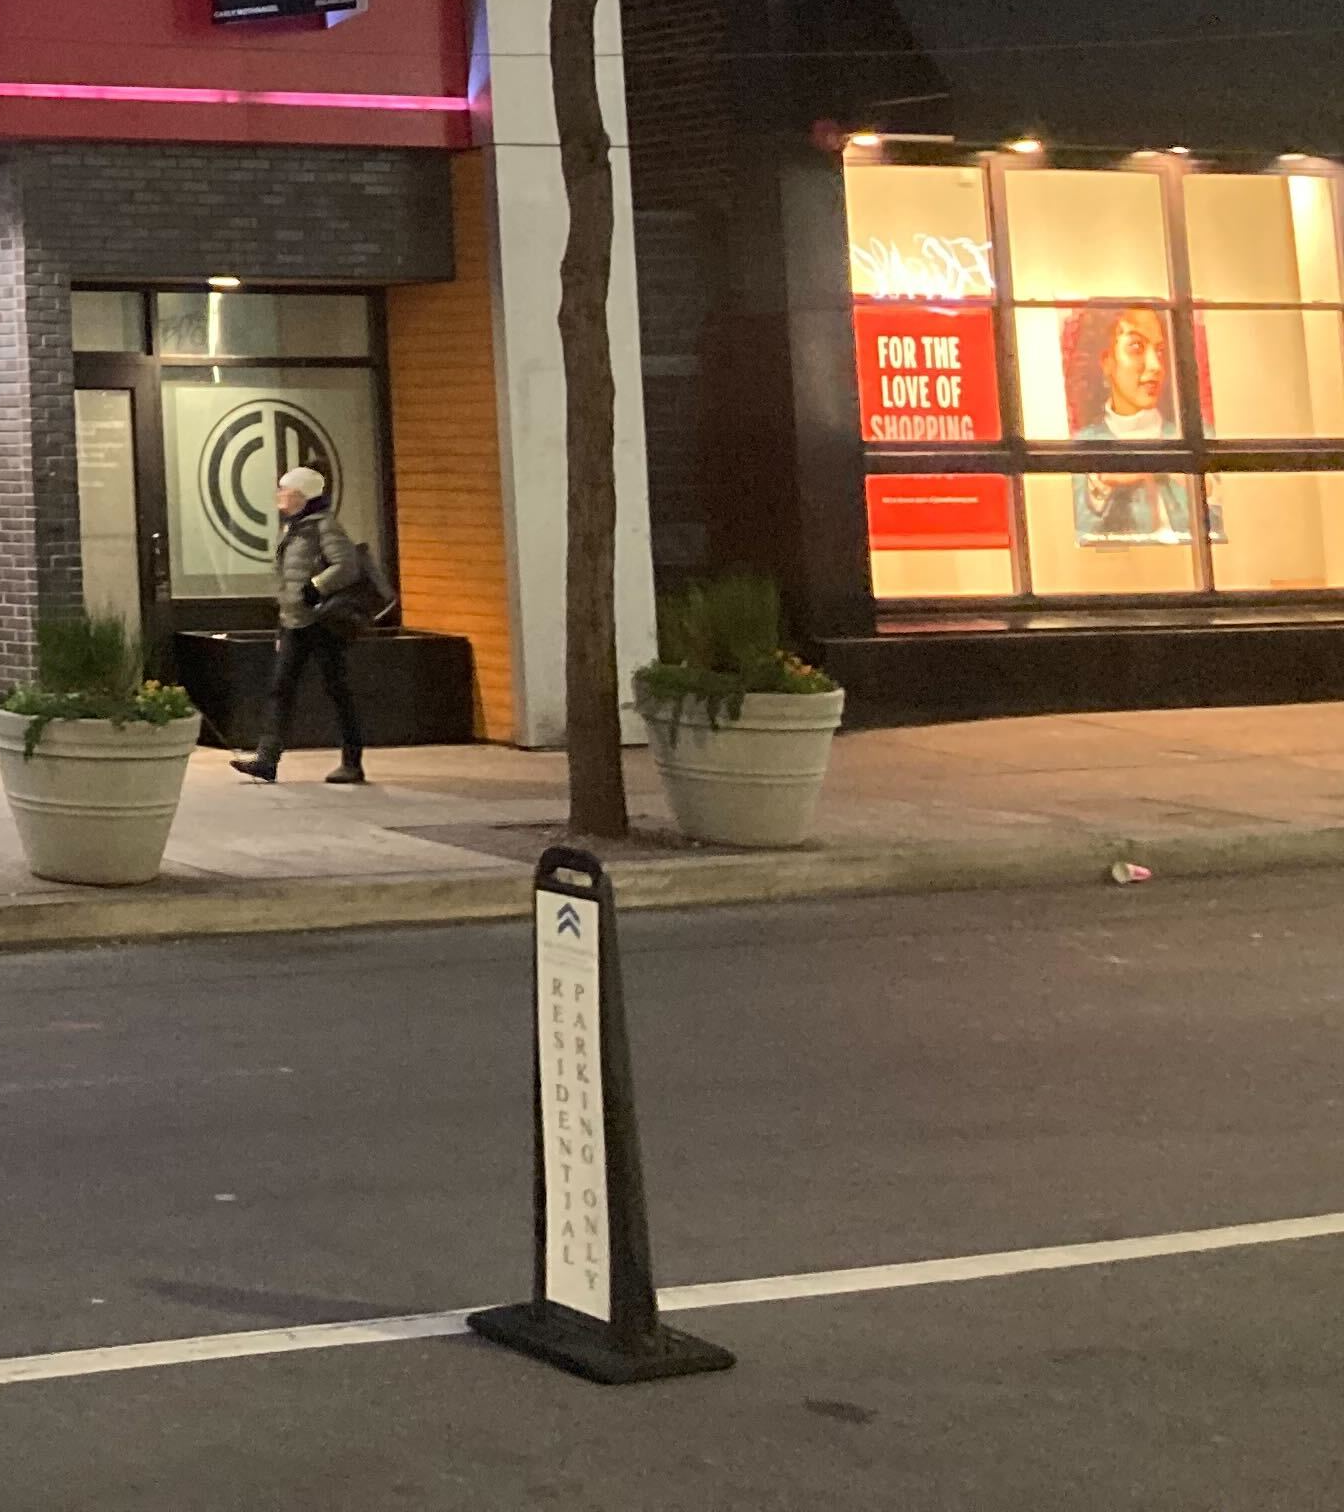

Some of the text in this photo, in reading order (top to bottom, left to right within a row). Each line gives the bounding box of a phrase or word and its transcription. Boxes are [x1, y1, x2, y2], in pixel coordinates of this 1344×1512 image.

[877, 335, 962, 370] FOR THE
[881, 375, 962, 409] LOVE OF
[870, 414, 975, 441] SHOPPING
